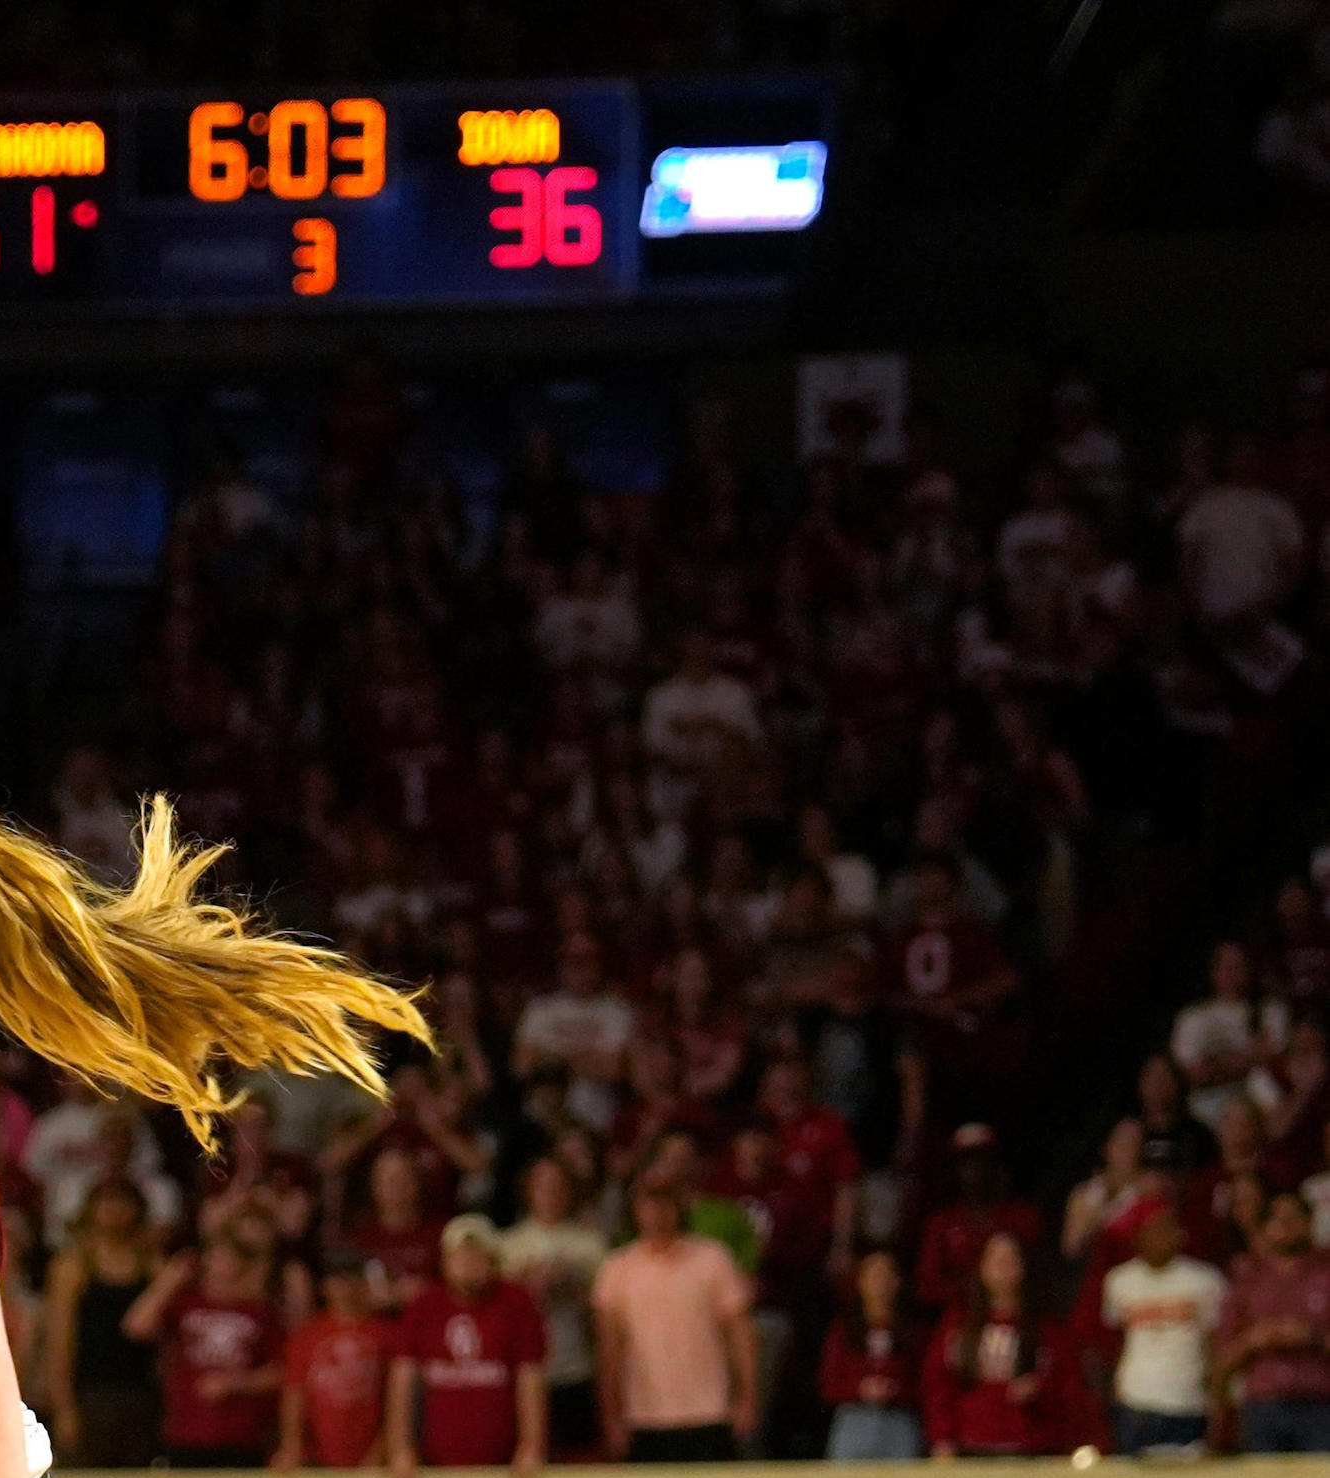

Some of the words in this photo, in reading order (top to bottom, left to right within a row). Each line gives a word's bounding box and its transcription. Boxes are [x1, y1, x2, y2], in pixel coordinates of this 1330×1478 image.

[189, 98, 386, 202] 6:03
[292, 217, 337, 296] 3
[489, 166, 602, 268] 36
